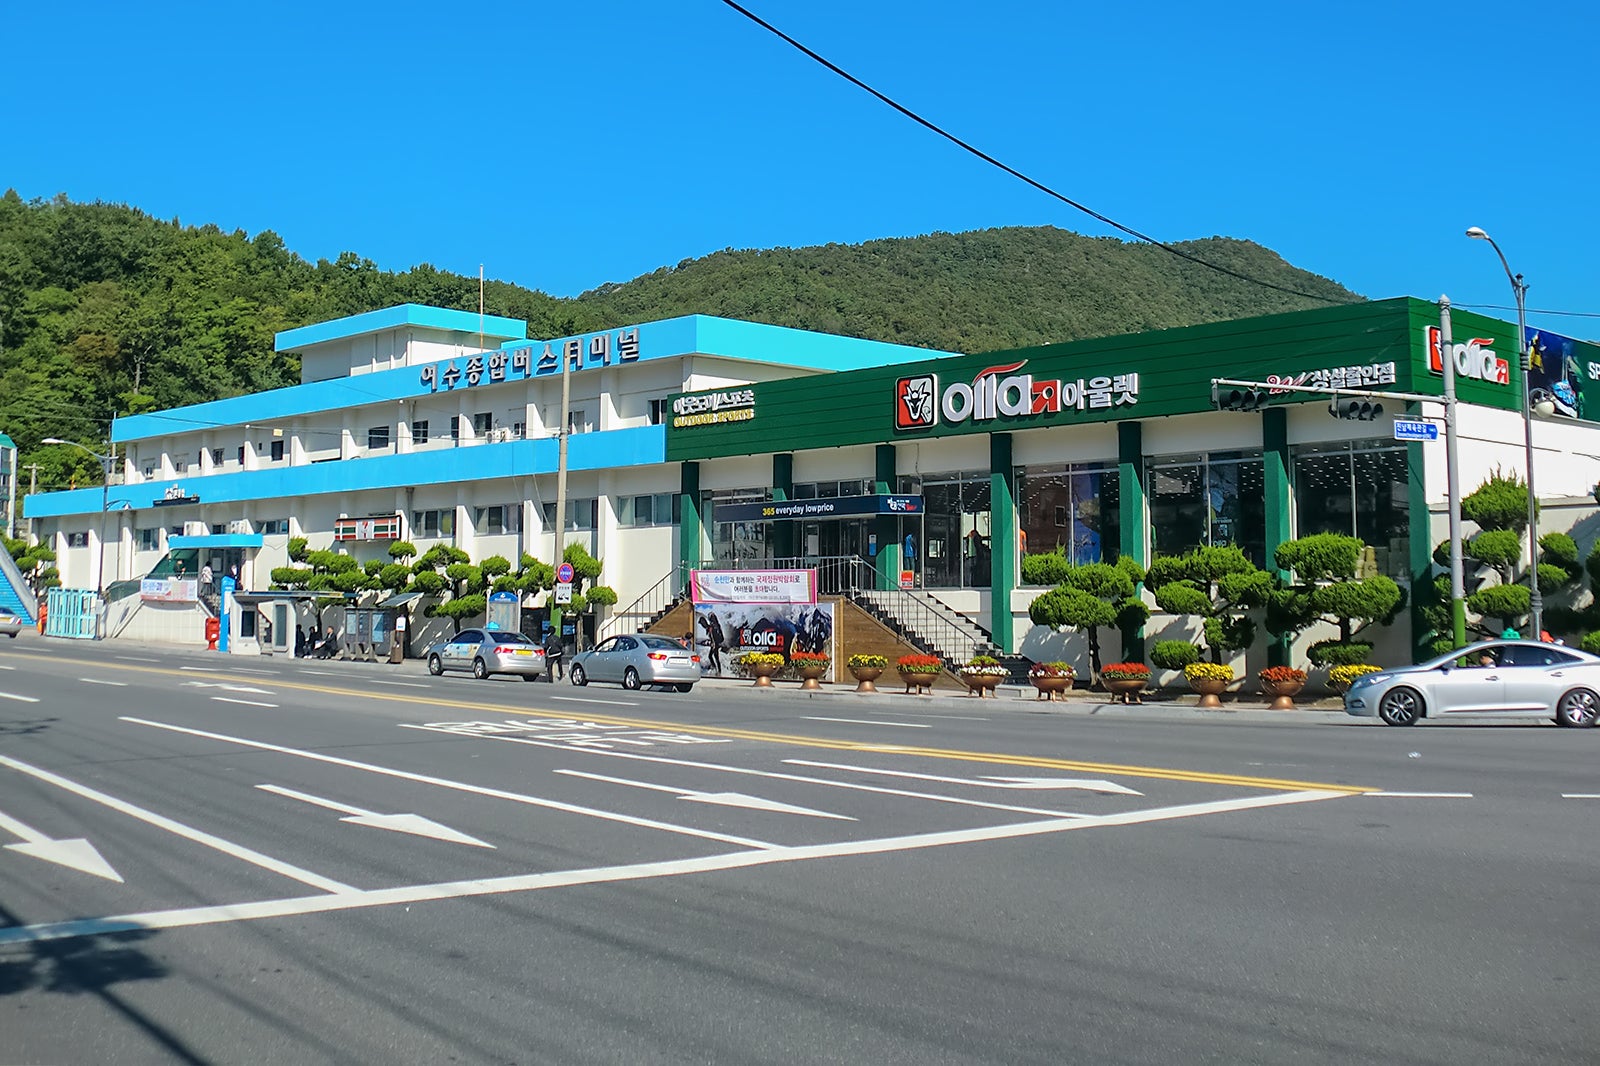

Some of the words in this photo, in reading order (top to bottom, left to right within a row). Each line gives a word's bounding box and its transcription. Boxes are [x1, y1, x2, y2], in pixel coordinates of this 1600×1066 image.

[421, 328, 640, 390] 여수종합버스터미널
[1311, 361, 1396, 389] 상설할인점
[1062, 373, 1138, 409] 아울렛
[674, 413, 717, 427] OUTDOOR
[717, 408, 755, 422] SPORTS
[762, 507, 775, 516] 365
[775, 504, 805, 516] everyday
